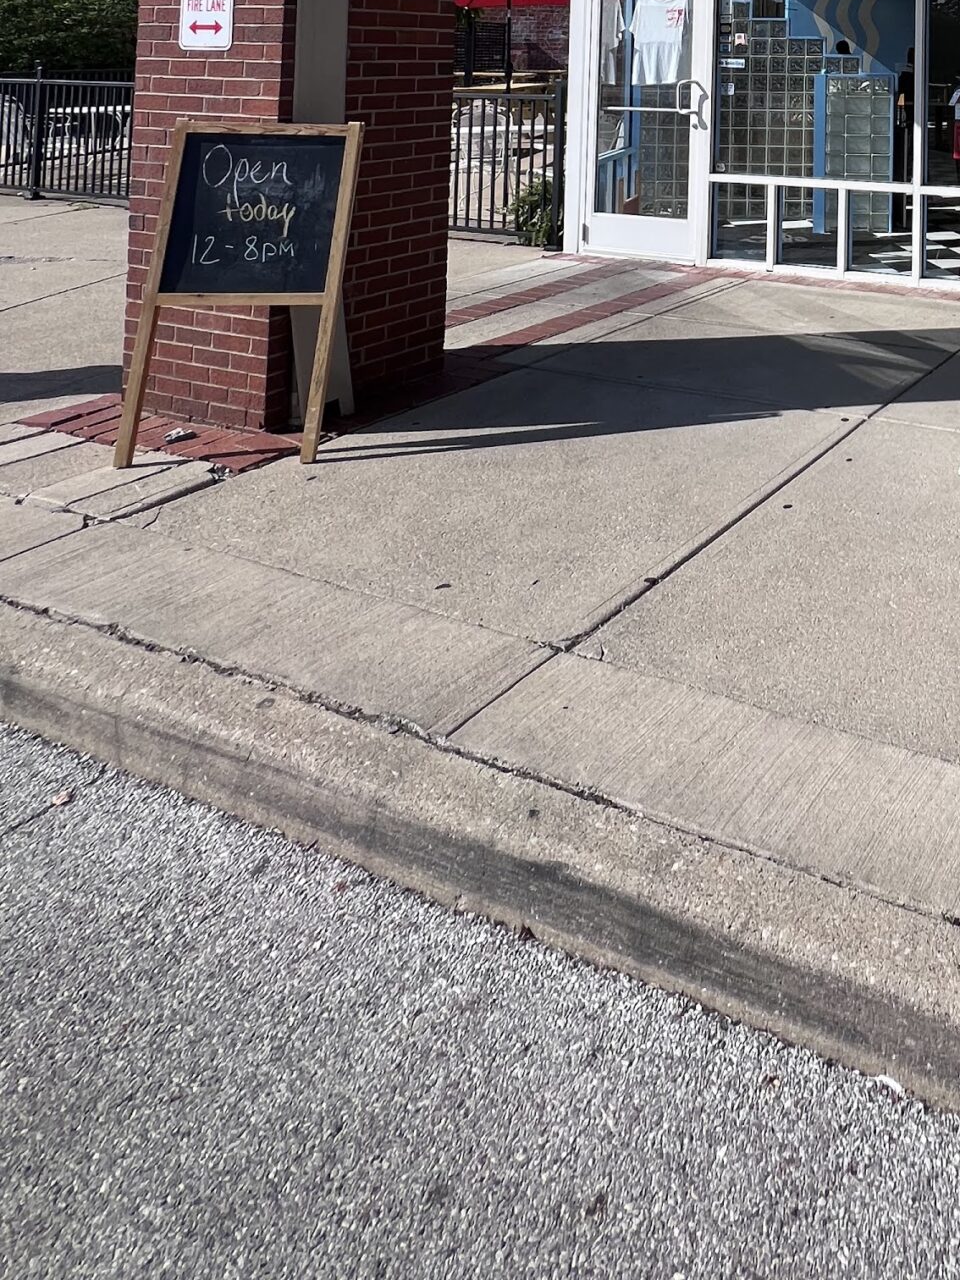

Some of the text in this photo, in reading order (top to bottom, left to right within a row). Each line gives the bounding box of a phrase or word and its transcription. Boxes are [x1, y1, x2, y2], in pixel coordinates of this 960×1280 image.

[203, 144, 293, 208] Open
[217, 192, 296, 238] today
[192, 233, 220, 264] 12
